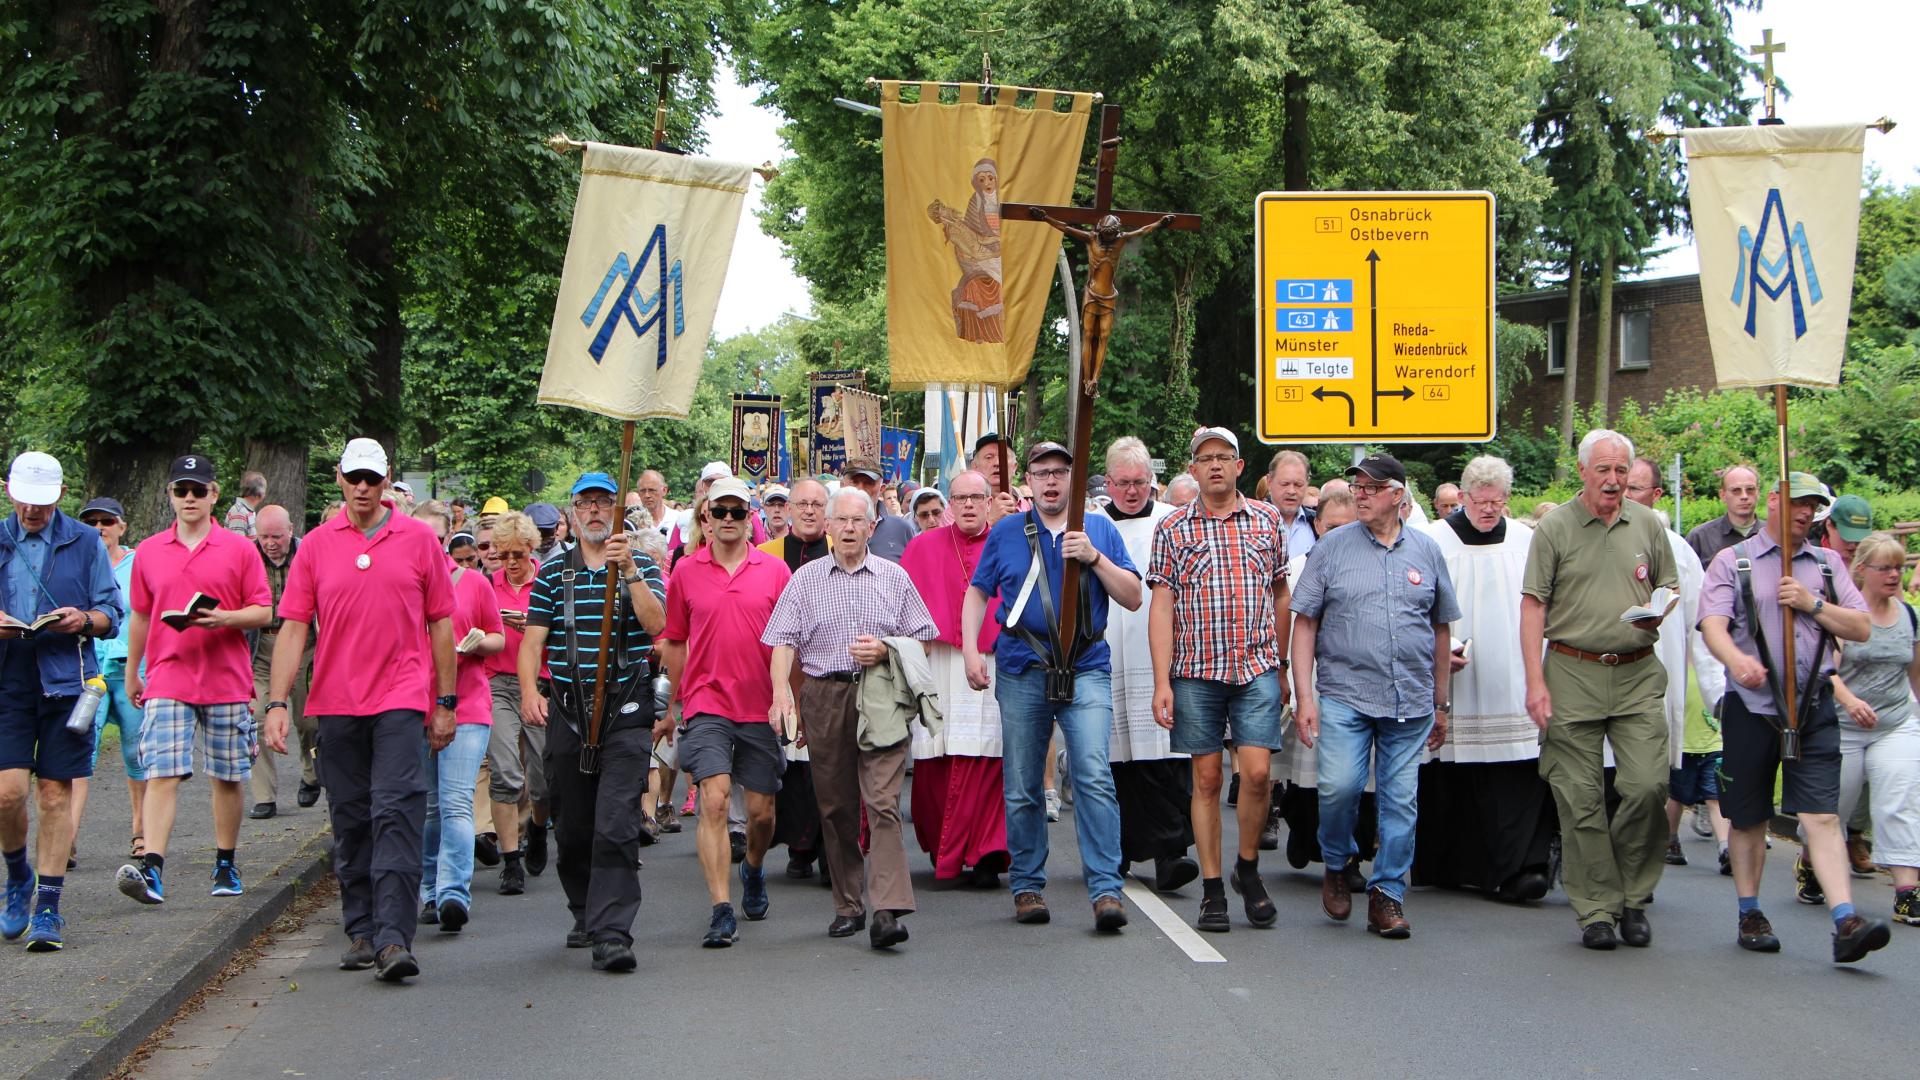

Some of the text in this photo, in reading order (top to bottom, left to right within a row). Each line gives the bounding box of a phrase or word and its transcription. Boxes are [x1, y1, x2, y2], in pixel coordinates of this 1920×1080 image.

[1350, 207, 1432, 221] Osnabrück
[1323, 219, 1335, 230] 51
[1350, 227, 1429, 241] Ostbevern
[1299, 286, 1304, 297] 1
[1295, 314, 1308, 325] 43
[1393, 323, 1435, 336] Rheda-
[1275, 338, 1339, 352] Münster
[1393, 342, 1468, 356] Wiedenbrück
[1306, 362, 1349, 377] Telgte
[1395, 365, 1476, 379] Warendorf
[1284, 388, 1296, 399] 51
[1429, 387, 1443, 398] 64
[184, 457, 197, 470] 3
